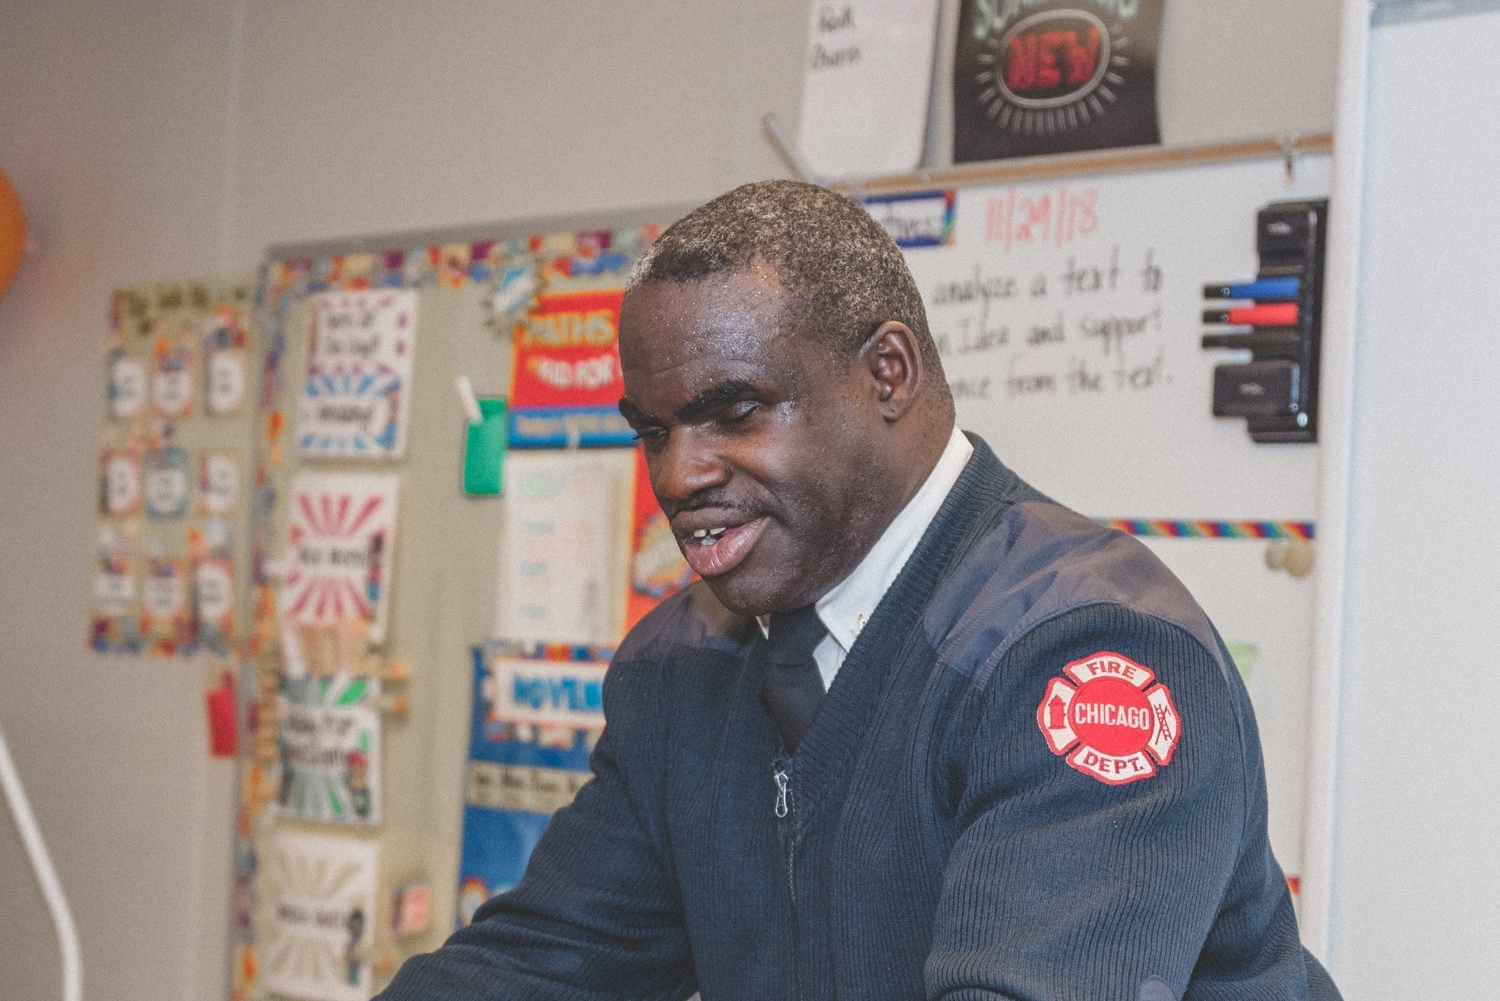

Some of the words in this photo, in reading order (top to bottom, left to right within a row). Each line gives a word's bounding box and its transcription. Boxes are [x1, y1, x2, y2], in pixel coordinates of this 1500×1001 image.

[1007, 27, 1101, 90] NEW
[985, 187, 1099, 253] 11/29/18
[1086, 660, 1137, 680] FIRE
[1074, 702, 1150, 731] CHICAGO
[1082, 750, 1145, 774] DEPT.
